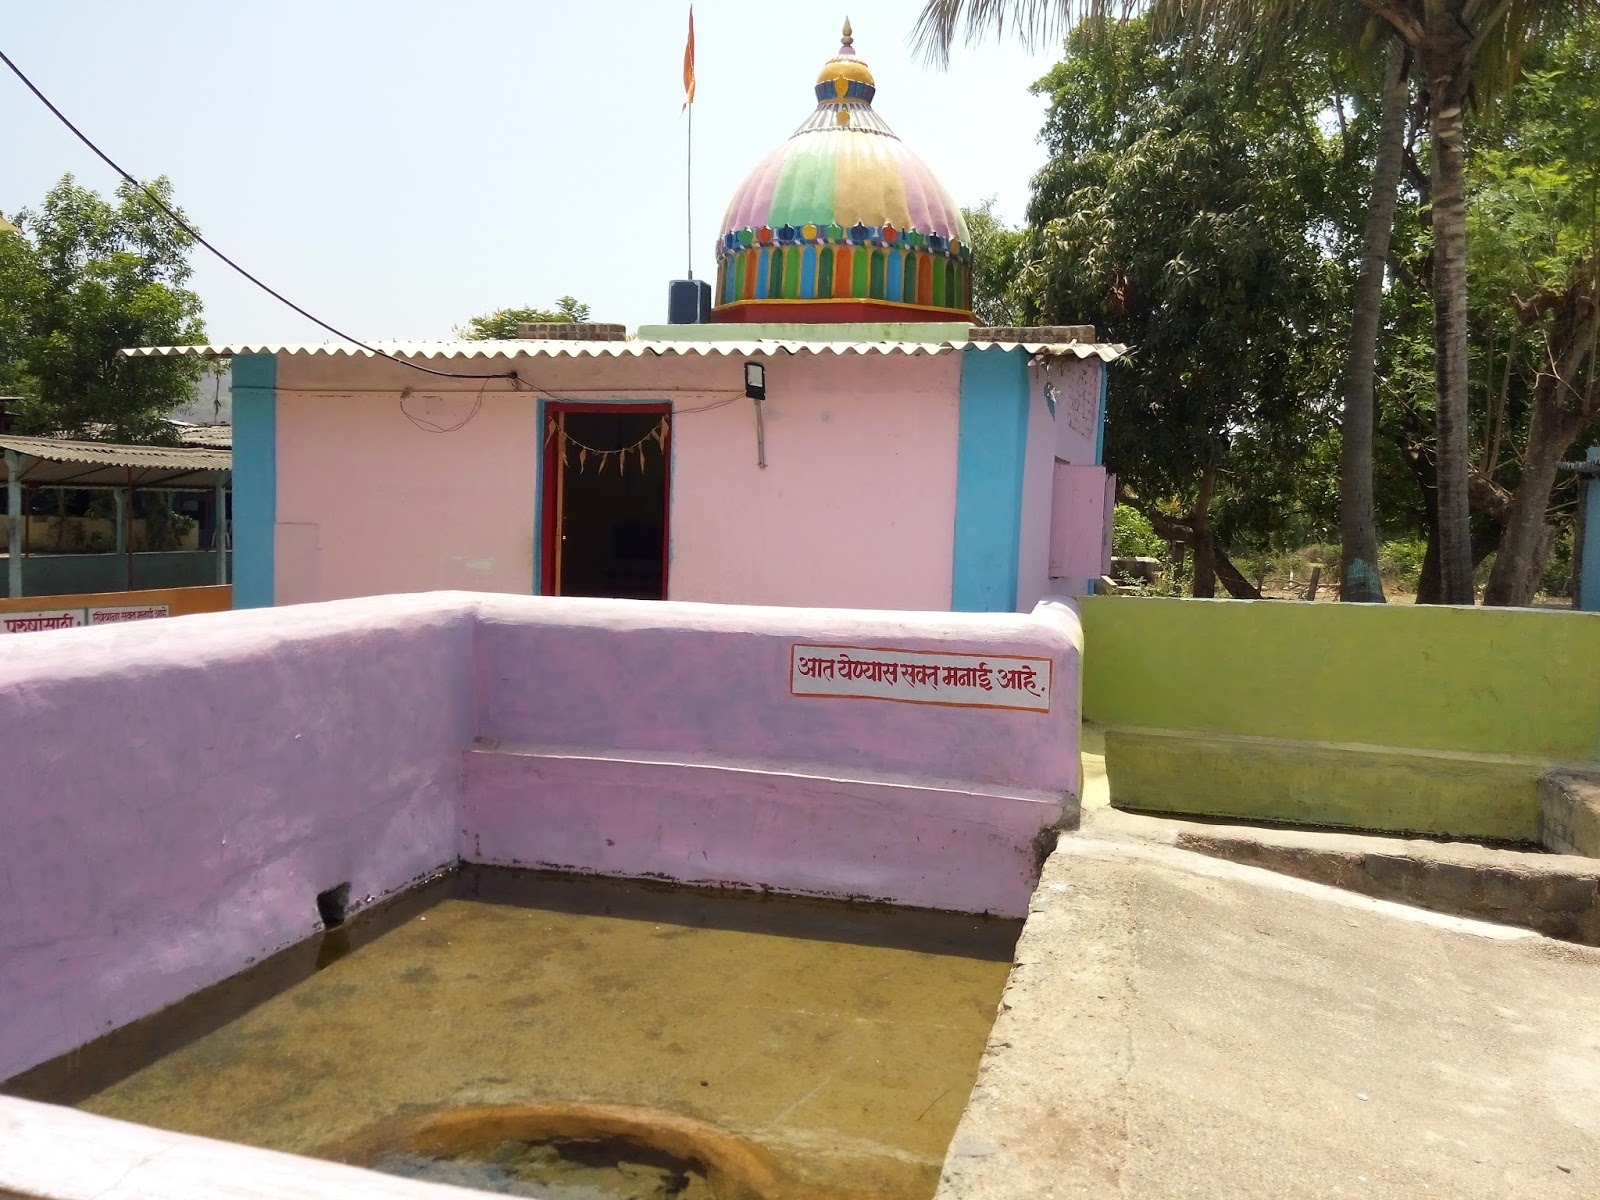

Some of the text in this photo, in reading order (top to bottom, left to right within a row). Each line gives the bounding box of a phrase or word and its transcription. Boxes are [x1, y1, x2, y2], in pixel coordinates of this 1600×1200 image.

[798, 656, 836, 682] आत
[837, 653, 899, 686] येण्यास
[900, 662, 940, 690] सक्त
[942, 661, 993, 691] मनाई
